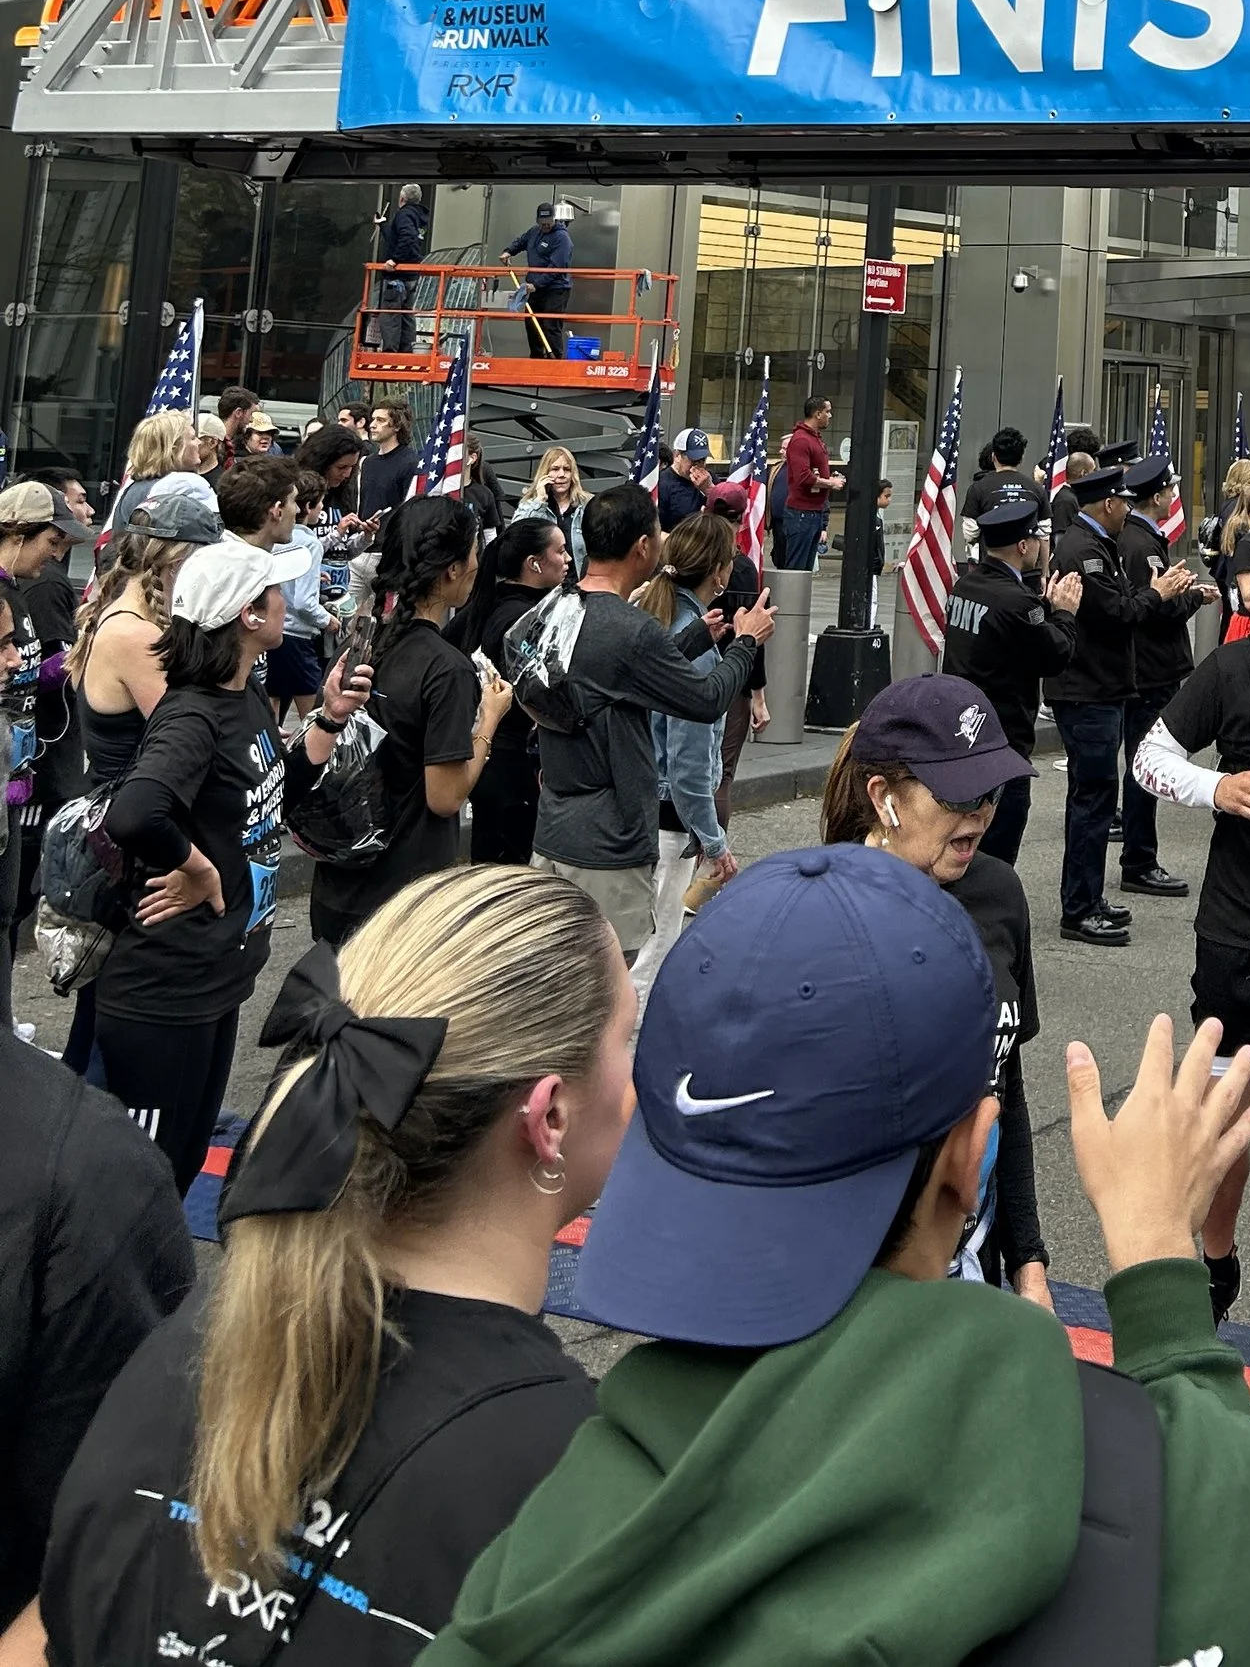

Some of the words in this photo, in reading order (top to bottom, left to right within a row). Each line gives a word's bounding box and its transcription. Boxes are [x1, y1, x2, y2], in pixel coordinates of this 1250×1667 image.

[443, 7, 456, 26] &
[459, 3, 545, 26] MUSEUM
[446, 74, 517, 98] RXR
[867, 265, 875, 275] NO
[876, 265, 901, 277] STANDING
[867, 276, 888, 288] Anytime
[607, 366, 629, 377] 3226
[948, 594, 989, 634] DNY
[872, 638, 881, 648] 40
